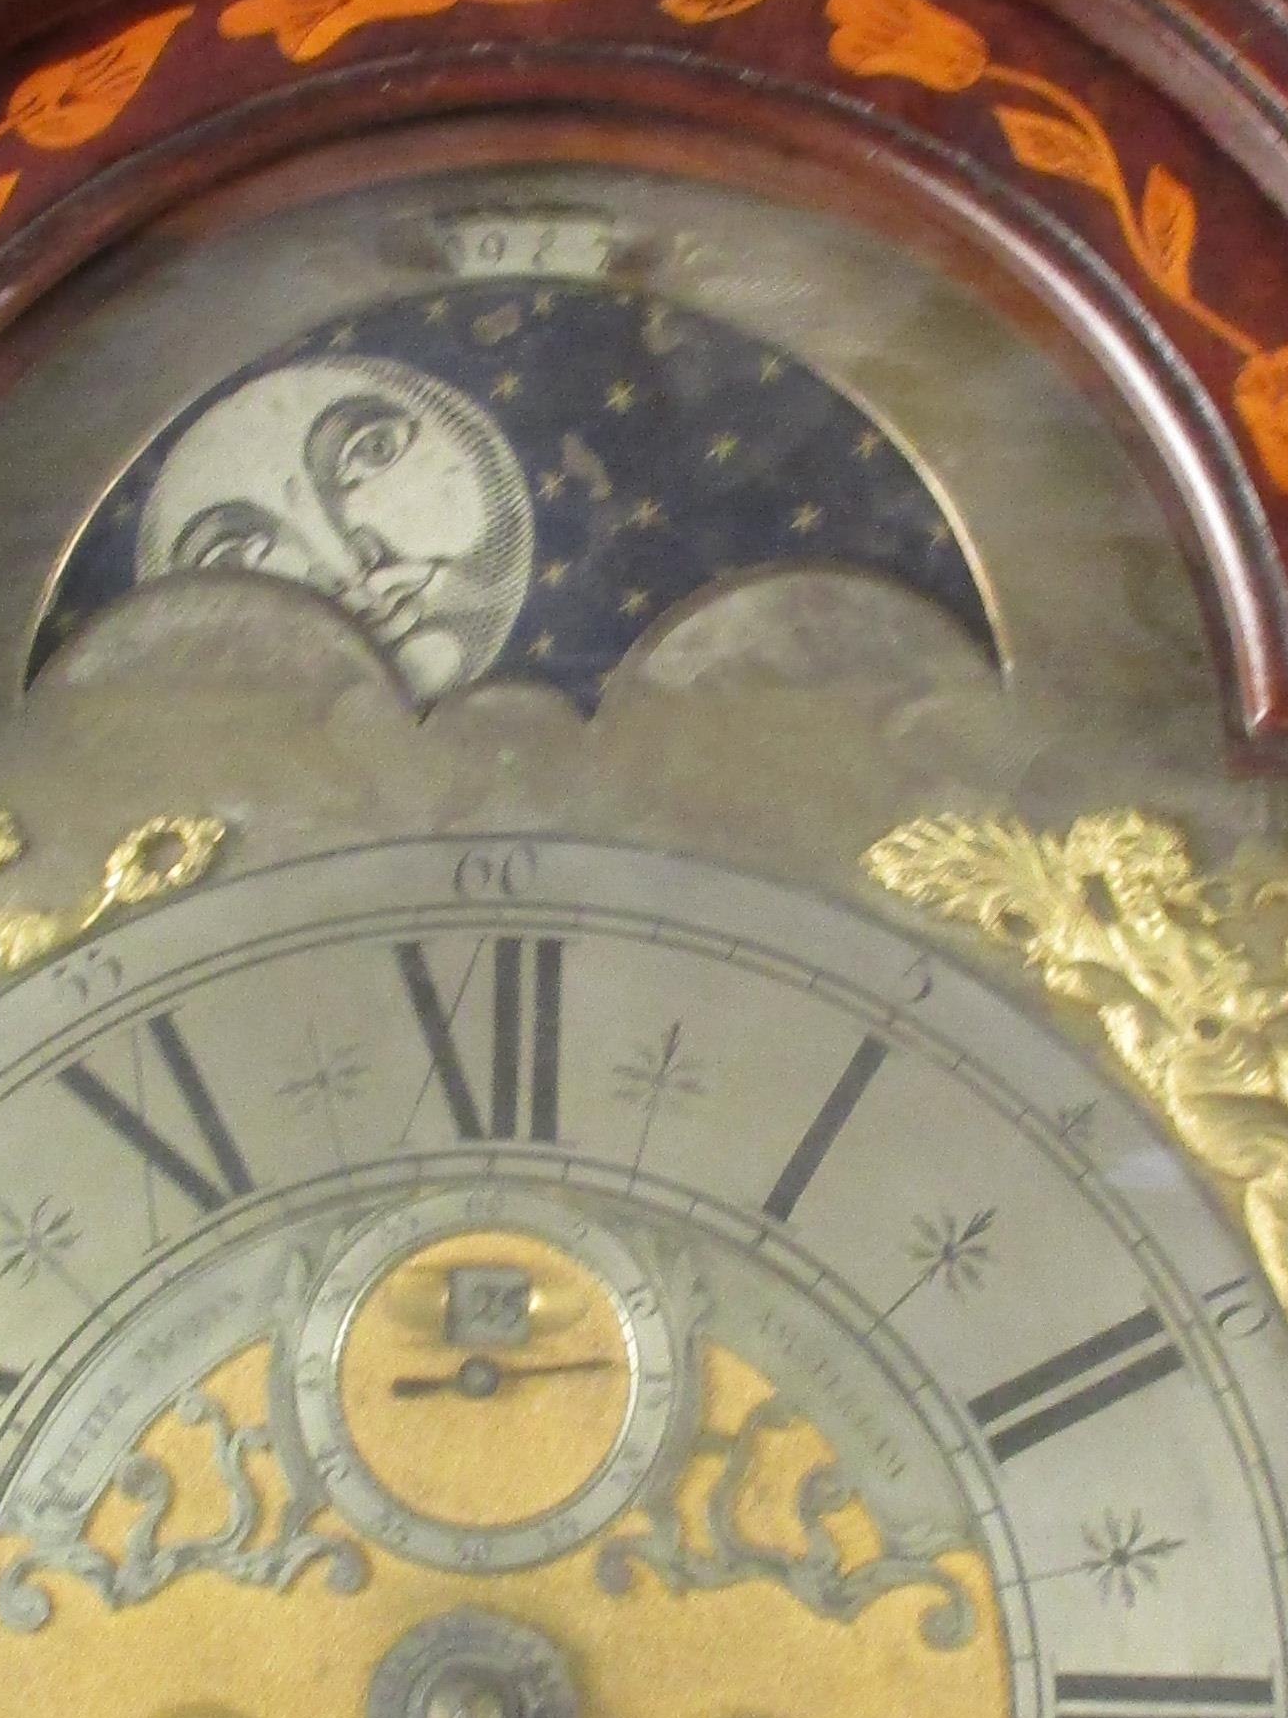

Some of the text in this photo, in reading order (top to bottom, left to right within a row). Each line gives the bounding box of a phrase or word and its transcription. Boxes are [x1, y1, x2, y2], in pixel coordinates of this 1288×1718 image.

[452, 841, 539, 898] 60
[392, 935, 568, 1145] XII
[762, 1031, 892, 1223] I
[54, 1005, 256, 1255] XI
[964, 1303, 1194, 1465] II
[1202, 1271, 1272, 1339] 10
